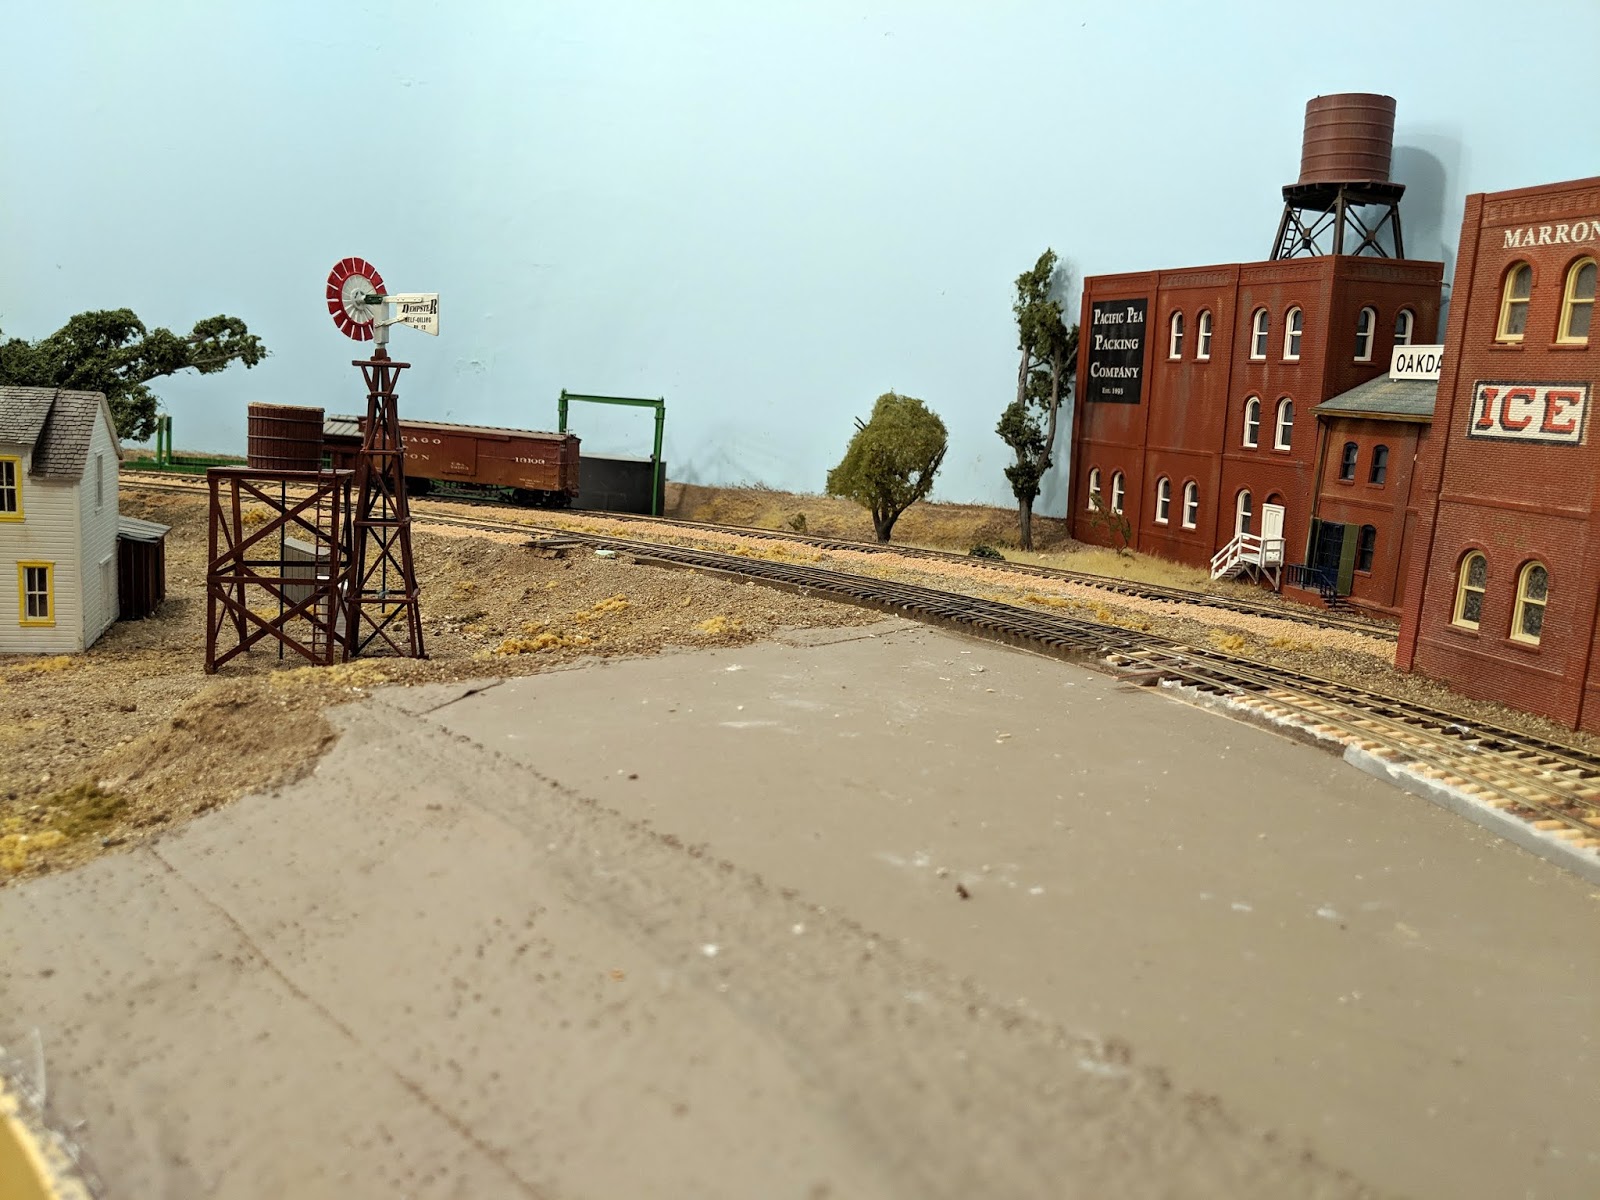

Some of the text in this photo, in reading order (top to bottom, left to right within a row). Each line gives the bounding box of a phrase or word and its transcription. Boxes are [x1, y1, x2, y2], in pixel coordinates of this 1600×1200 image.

[402, 298, 437, 315] DEMPSTER
[1093, 306, 1144, 325] PACIFIC PEA
[1094, 334, 1139, 351] PACKING
[1090, 361, 1140, 378] COMPANY
[1396, 353, 1443, 374] OAKDA
[1475, 387, 1582, 435] ICE
